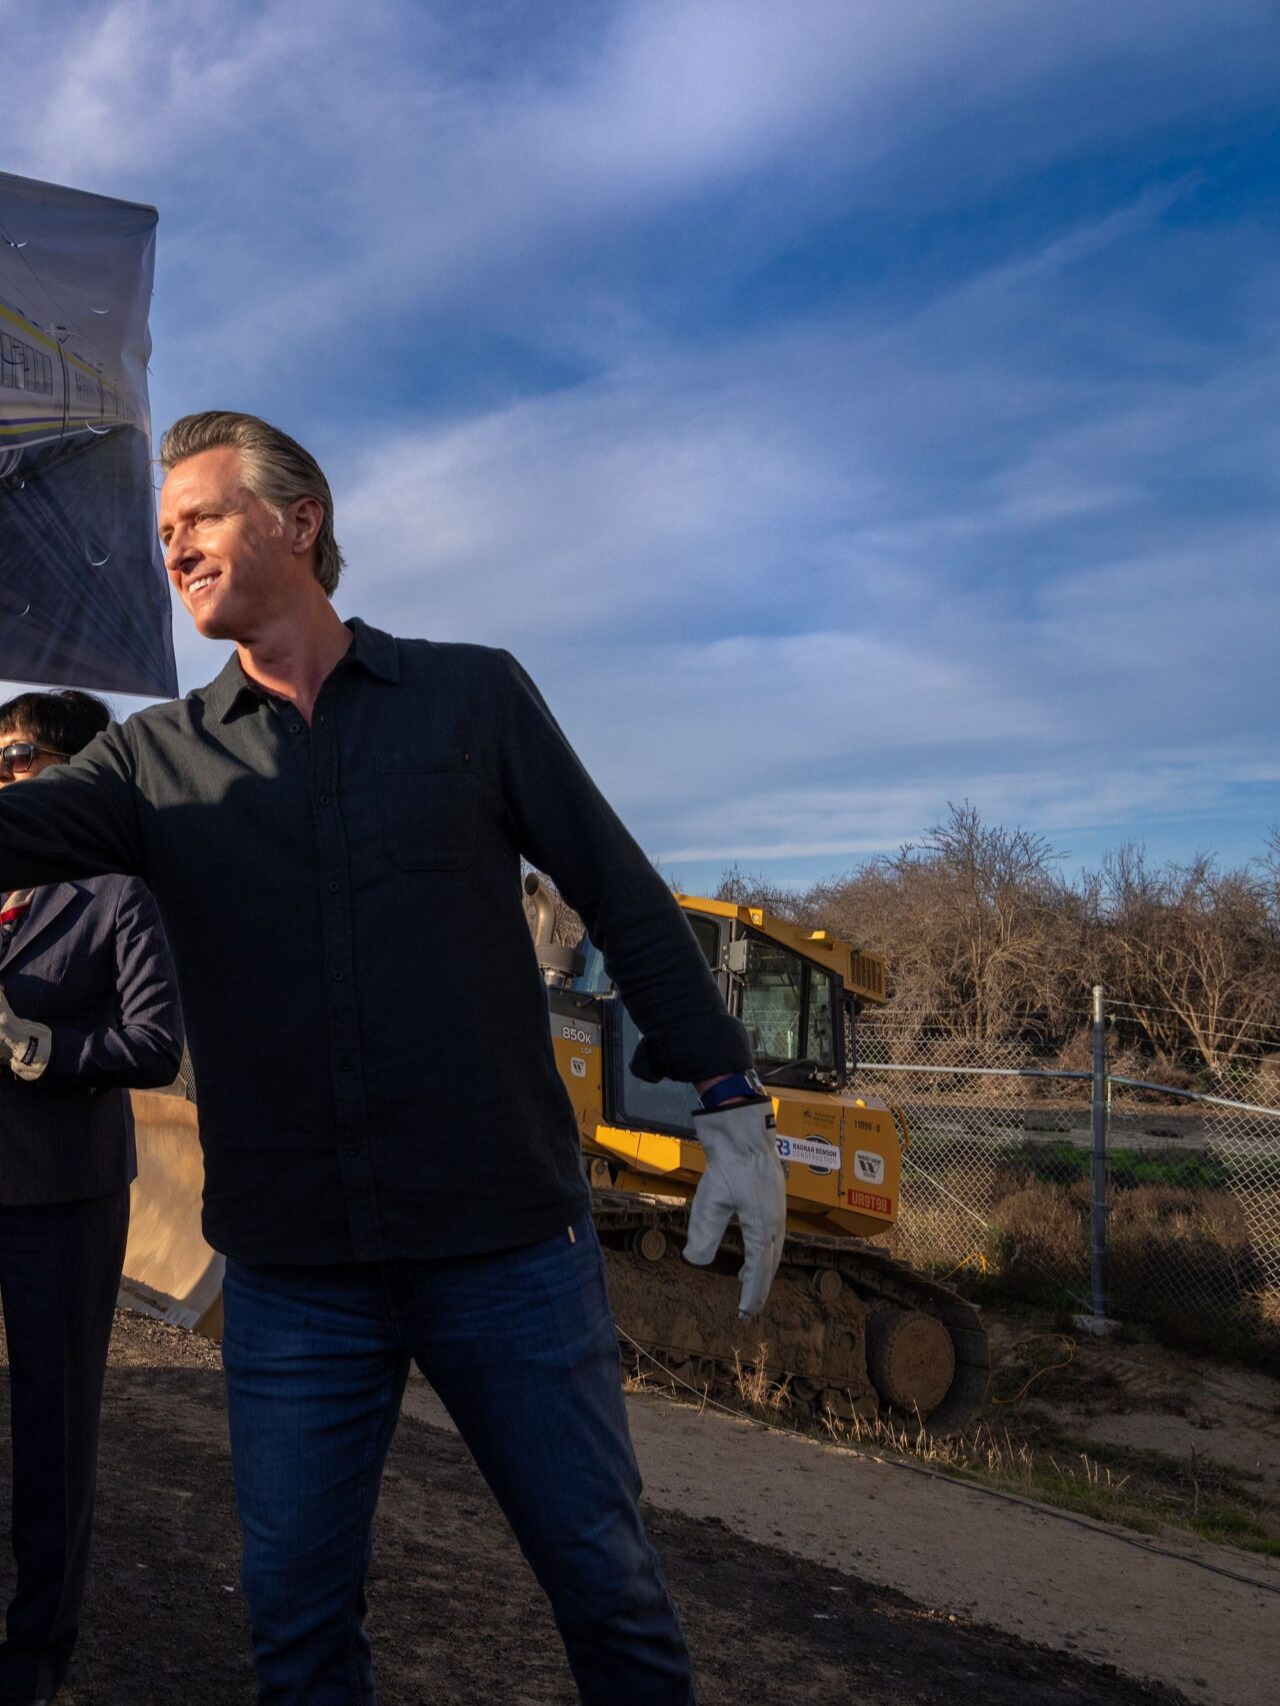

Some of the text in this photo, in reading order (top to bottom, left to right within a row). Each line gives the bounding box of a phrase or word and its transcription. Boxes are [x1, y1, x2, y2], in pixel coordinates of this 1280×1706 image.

[562, 1027, 591, 1044] 850K
[793, 1143, 836, 1157] RAGNAR BENSON
[793, 1151, 837, 1164] CONSTRUCTION
[851, 1190, 888, 1213] UR9T98
